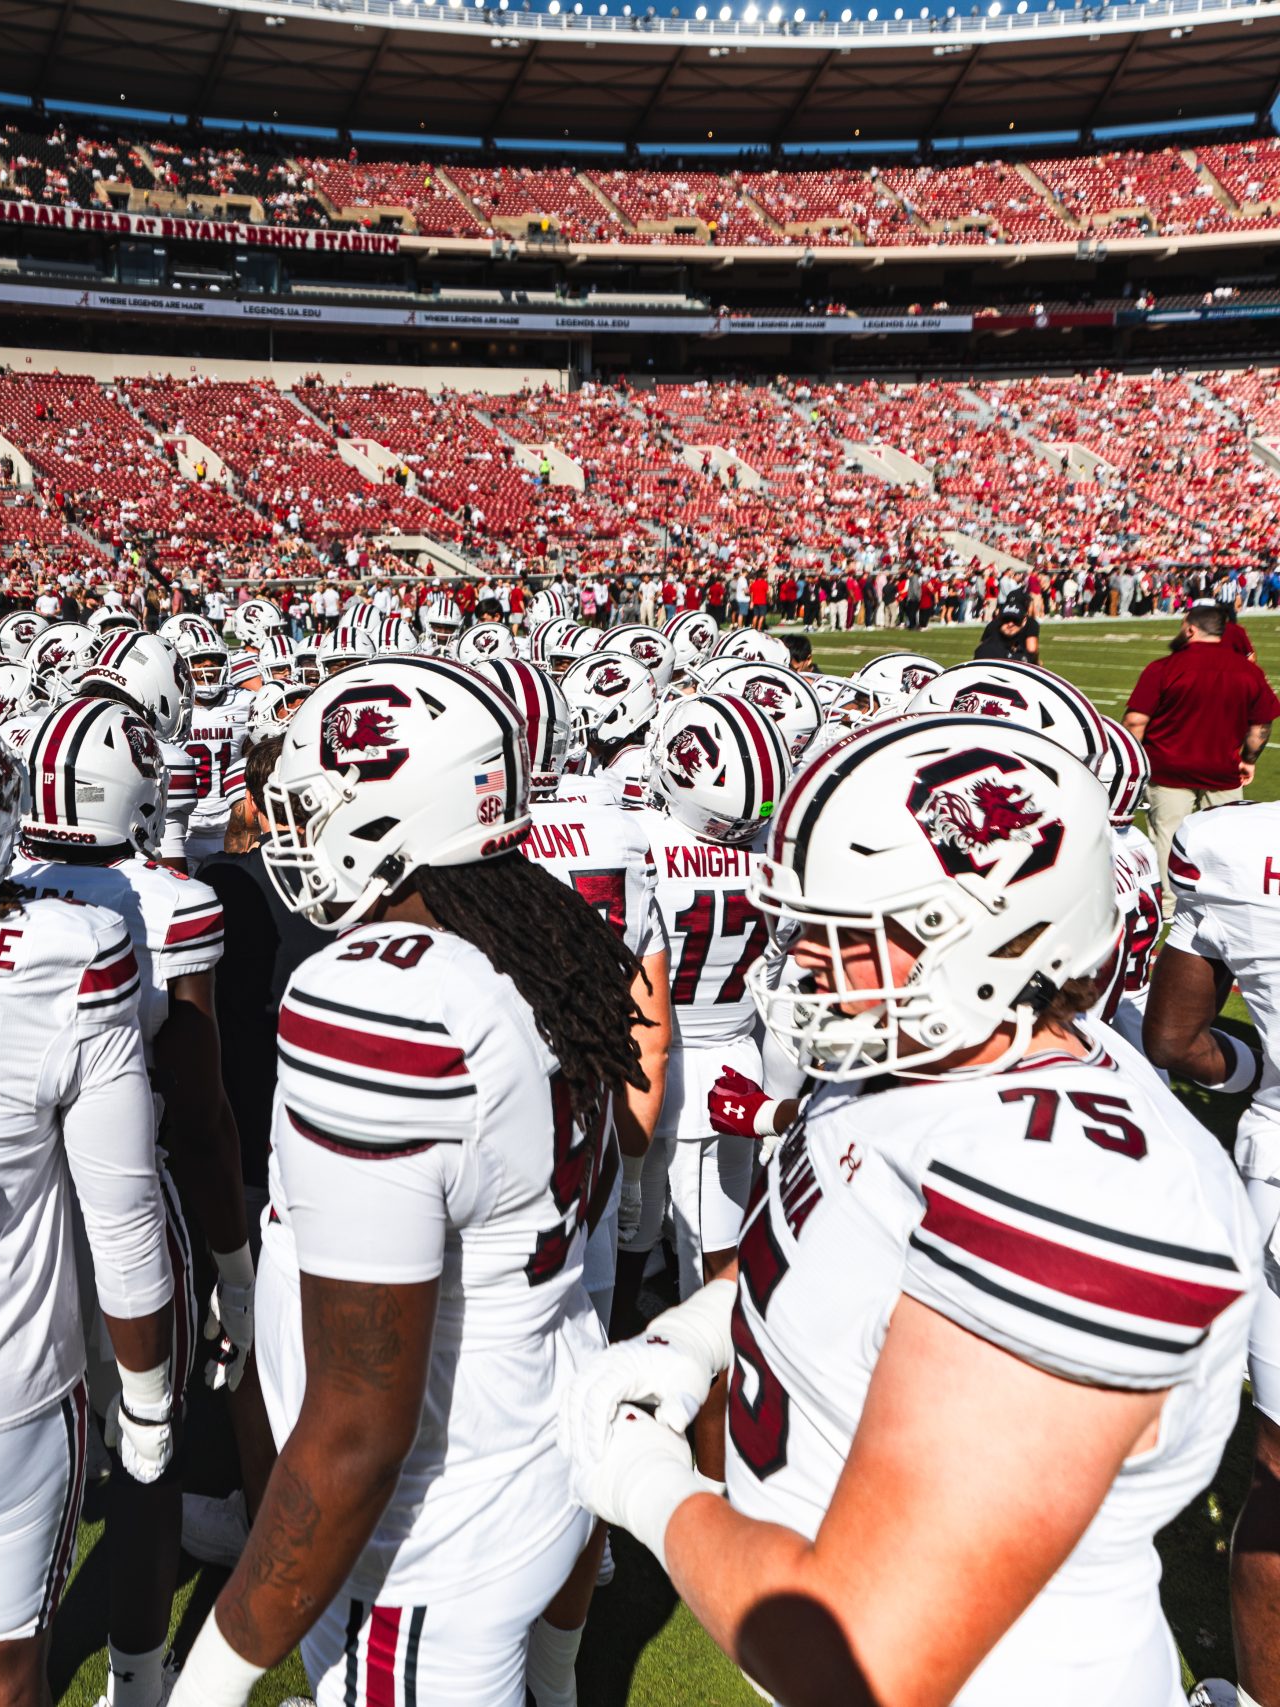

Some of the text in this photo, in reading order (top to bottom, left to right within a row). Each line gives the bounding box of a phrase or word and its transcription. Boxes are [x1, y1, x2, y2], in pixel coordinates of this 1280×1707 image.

[71, 208, 131, 234] FIELD
[135, 217, 156, 234] AT
[161, 217, 309, 249] BRYANT-DENNY
[314, 230, 400, 254] STADIUM
[98, 295, 204, 311] WHERE LEGENDS ARE MADE
[243, 305, 322, 318] LEGENDS.UA.EDU
[424, 314, 450, 323] WHERE
[451, 315, 483, 324] LEGENDS
[555, 318, 630, 328] LEGENDS.UA.EDU
[182, 727, 234, 741] AROLINA
[44, 772, 55, 785] IP
[664, 845, 753, 878] KNIGHT
[671, 888, 783, 1006] 17
[997, 1087, 1149, 1161] 75
